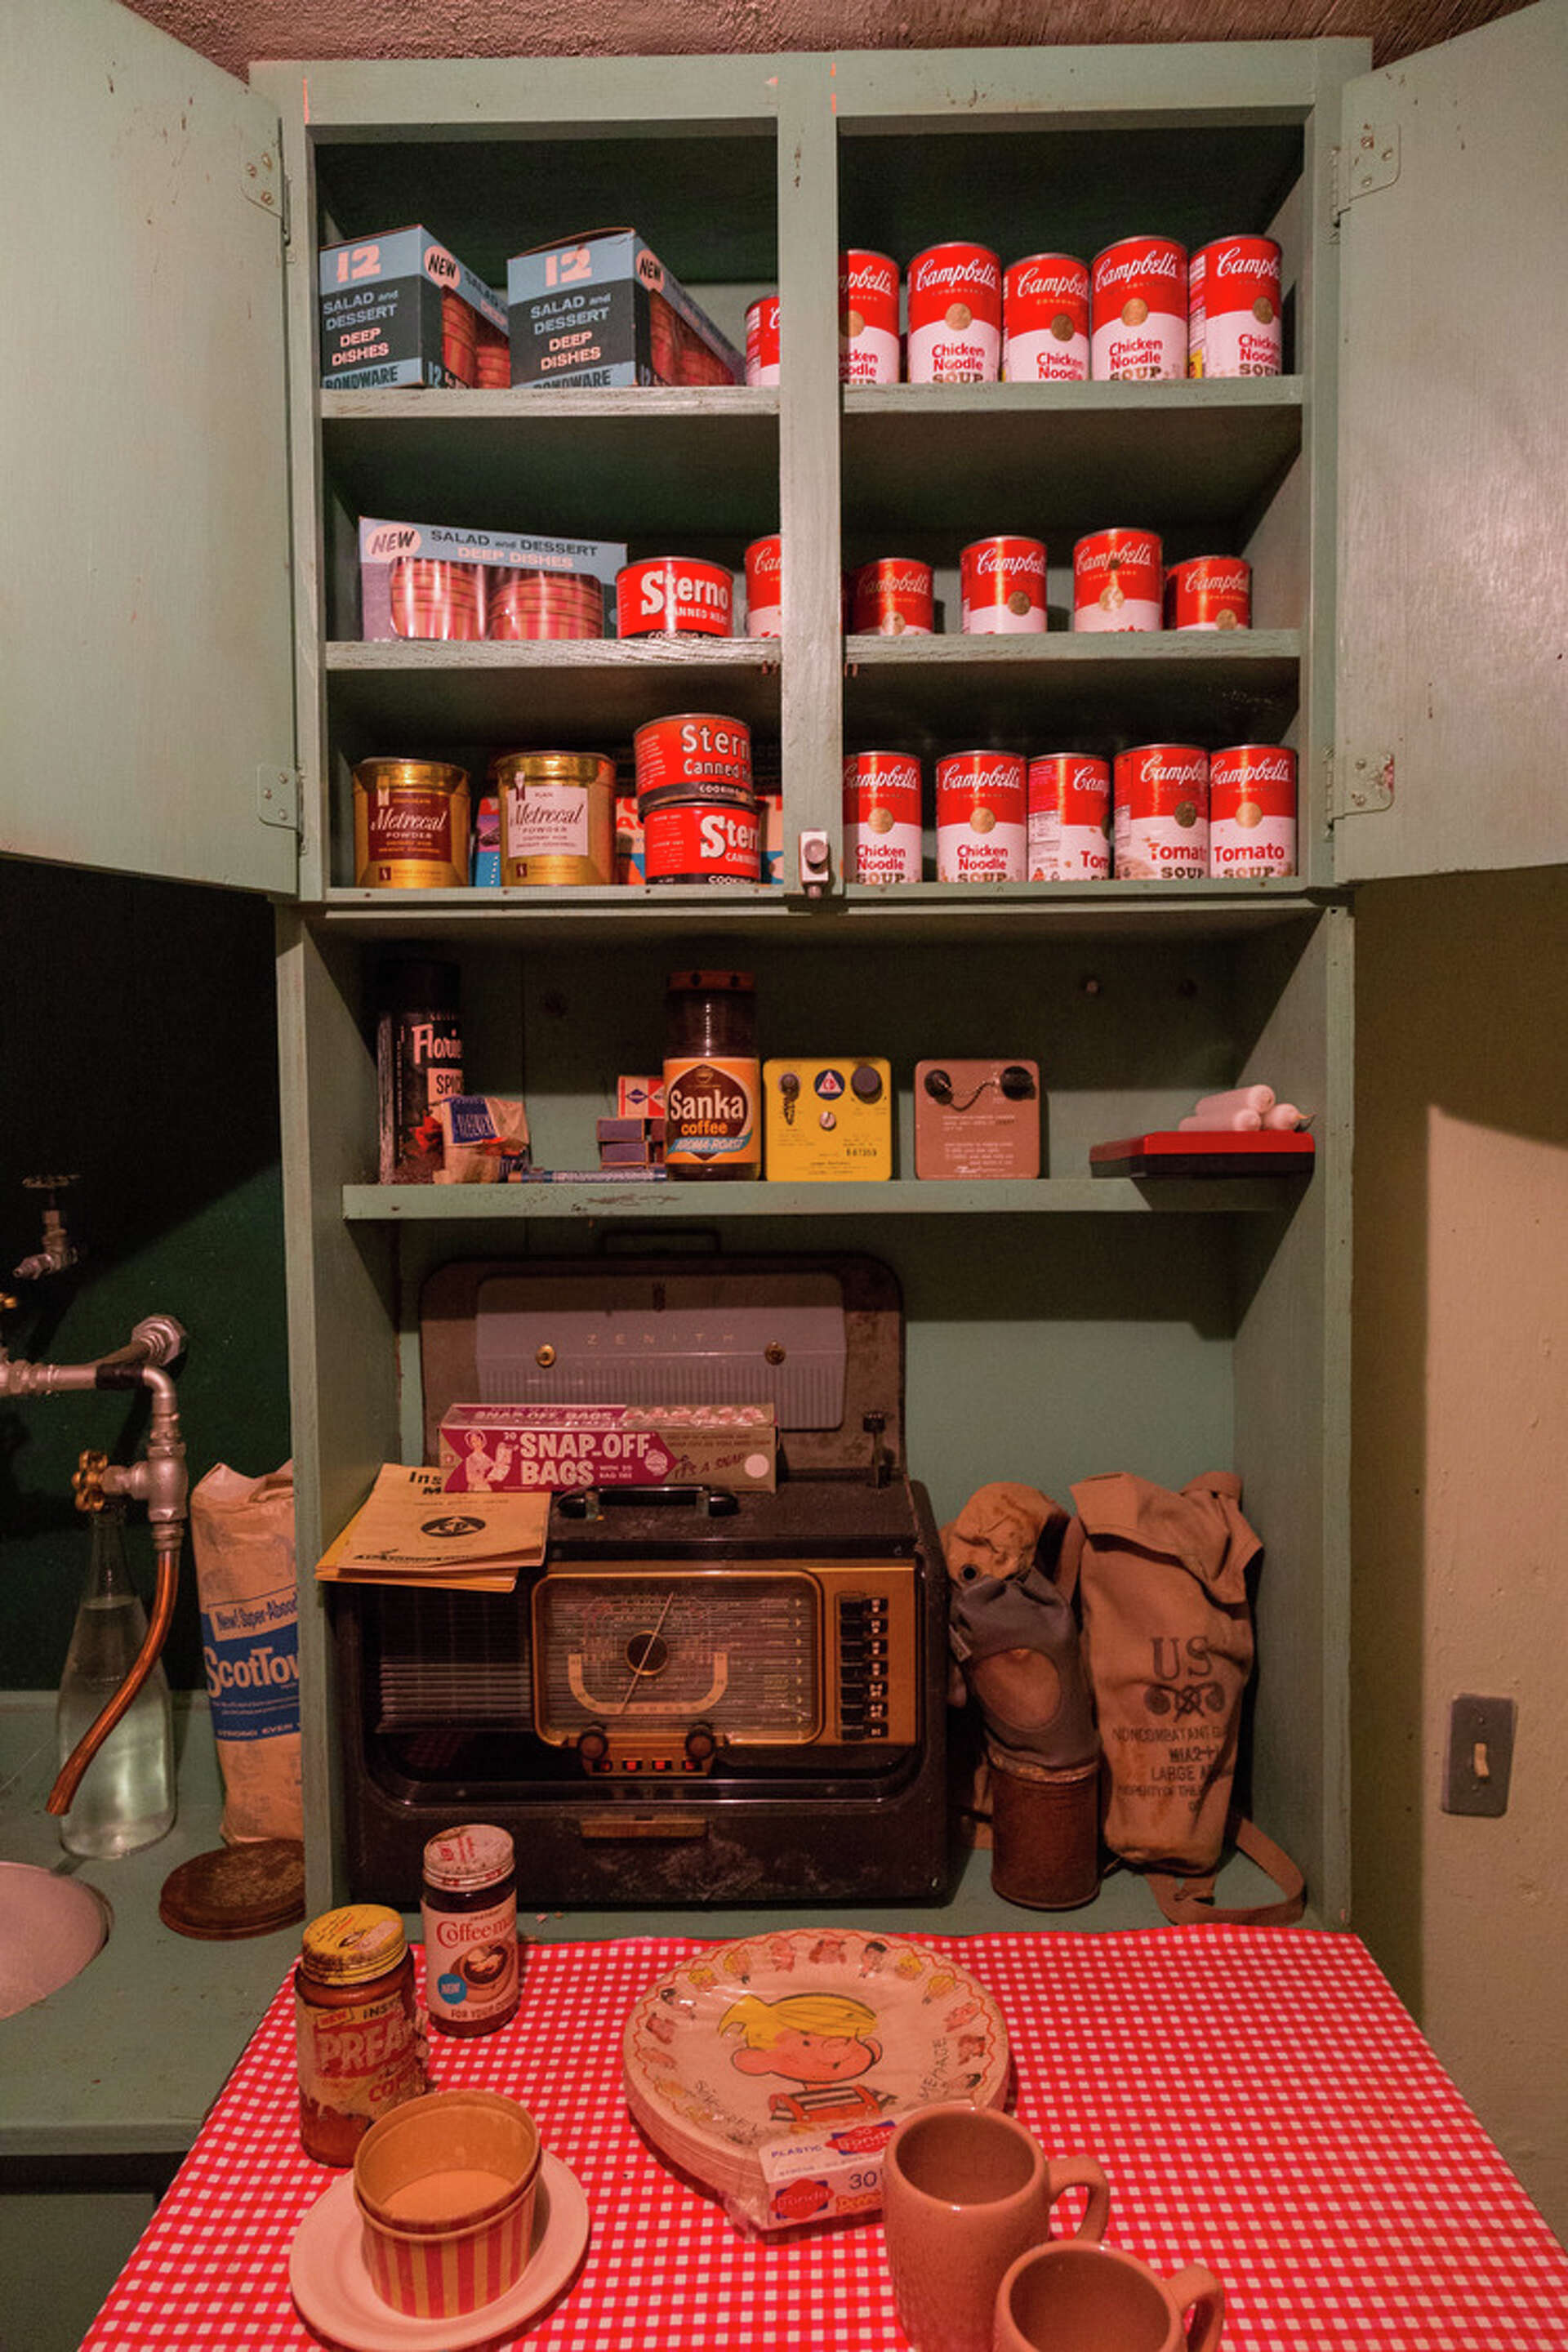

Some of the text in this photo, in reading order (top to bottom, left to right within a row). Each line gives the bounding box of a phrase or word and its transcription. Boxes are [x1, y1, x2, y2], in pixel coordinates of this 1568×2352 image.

[336, 245, 382, 283] 12
[427, 253, 457, 279] NEW
[545, 247, 592, 287] 12
[639, 257, 662, 283] NEW
[323, 289, 399, 315] SALAD and
[531, 292, 612, 318] SALAD and
[326, 303, 399, 332] DESSERT
[533, 307, 610, 335] DESSERT
[340, 327, 381, 348] DEEP
[549, 331, 593, 352] DEEP
[1109, 337, 1163, 357] Chicken
[332, 342, 390, 367] DISHES
[540, 346, 602, 371] DISHES
[932, 342, 986, 359] Chicken
[933, 358, 984, 372] Noodle
[1110, 353, 1161, 372] Noodle
[933, 372, 984, 384] SOUP
[371, 530, 415, 555] NEW
[430, 530, 599, 557] SALAD and DESSERT
[457, 546, 573, 568] DEEP DISHES
[640, 570, 728, 617] Sterno
[666, 607, 708, 620] ANNED
[370, 806, 448, 831] Metrecal
[510, 802, 585, 826] Metrecal
[385, 831, 433, 840] POWDER
[856, 843, 906, 859] Chicken
[956, 844, 1009, 859] Chicken
[1214, 842, 1285, 863] Tomato
[856, 858, 905, 871] Noodle
[958, 858, 1007, 871] Noodle
[1223, 866, 1276, 880] SOUP
[855, 871, 906, 884] SOUP
[957, 871, 1008, 884] SOUP
[670, 1088, 745, 1120] Sanka
[680, 1119, 729, 1136] coffee
[586, 1332, 736, 1346] ZENITH
[519, 1432, 651, 1459] SNAP-OFF
[520, 1459, 595, 1486] BAGS
[1151, 1765, 1195, 1781] LARGE
[317, 2020, 412, 2072] PREA
